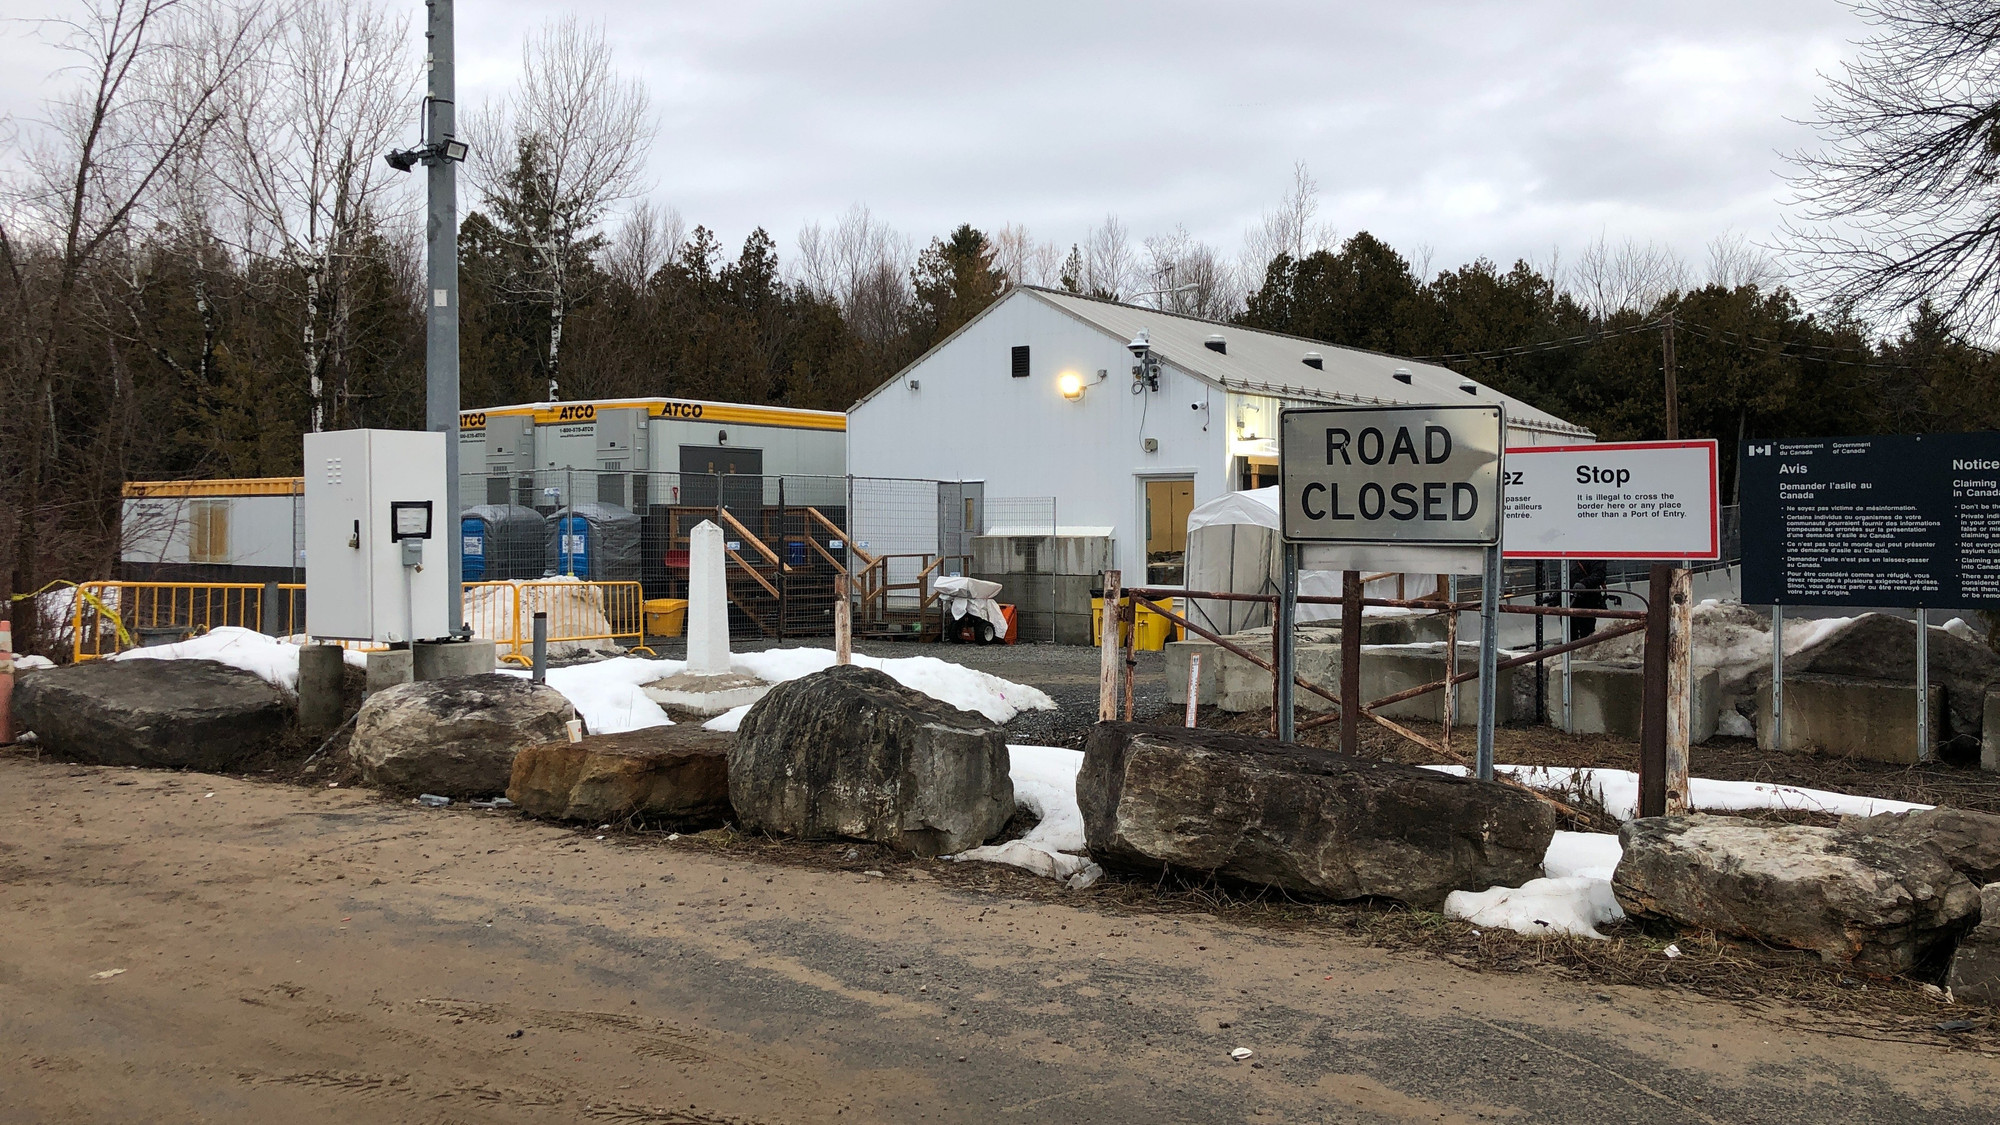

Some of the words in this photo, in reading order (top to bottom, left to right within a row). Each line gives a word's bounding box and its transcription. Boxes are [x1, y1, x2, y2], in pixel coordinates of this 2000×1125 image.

[560, 405, 594, 420] ATCO
[662, 402, 702, 418] ATCO
[1326, 426, 1452, 465] ROAD
[1779, 463, 1808, 474] Avis
[1953, 459, 1999, 470] Notice
[1576, 465, 1630, 488] Stop
[1953, 479, 1996, 488] Claiming
[1302, 482, 1478, 520] CLOSED
